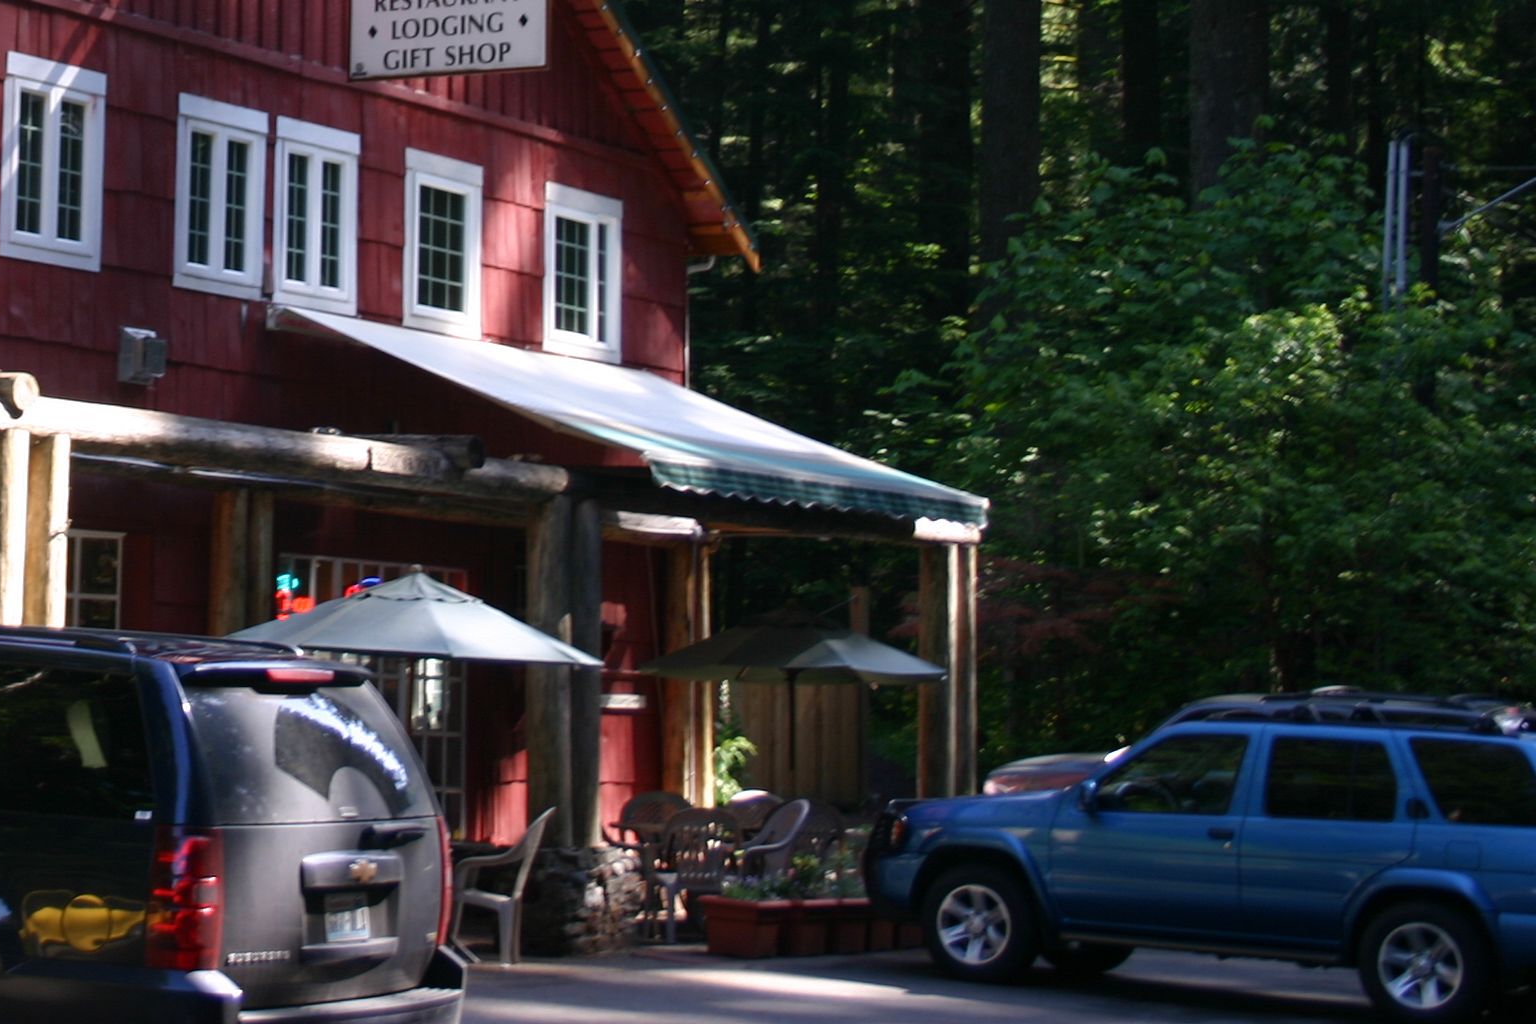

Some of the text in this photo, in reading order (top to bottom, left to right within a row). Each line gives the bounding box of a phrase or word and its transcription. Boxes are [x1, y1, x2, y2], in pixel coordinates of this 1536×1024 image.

[390, 11, 505, 41] LODGING
[383, 42, 512, 70] GIFT SHOP
